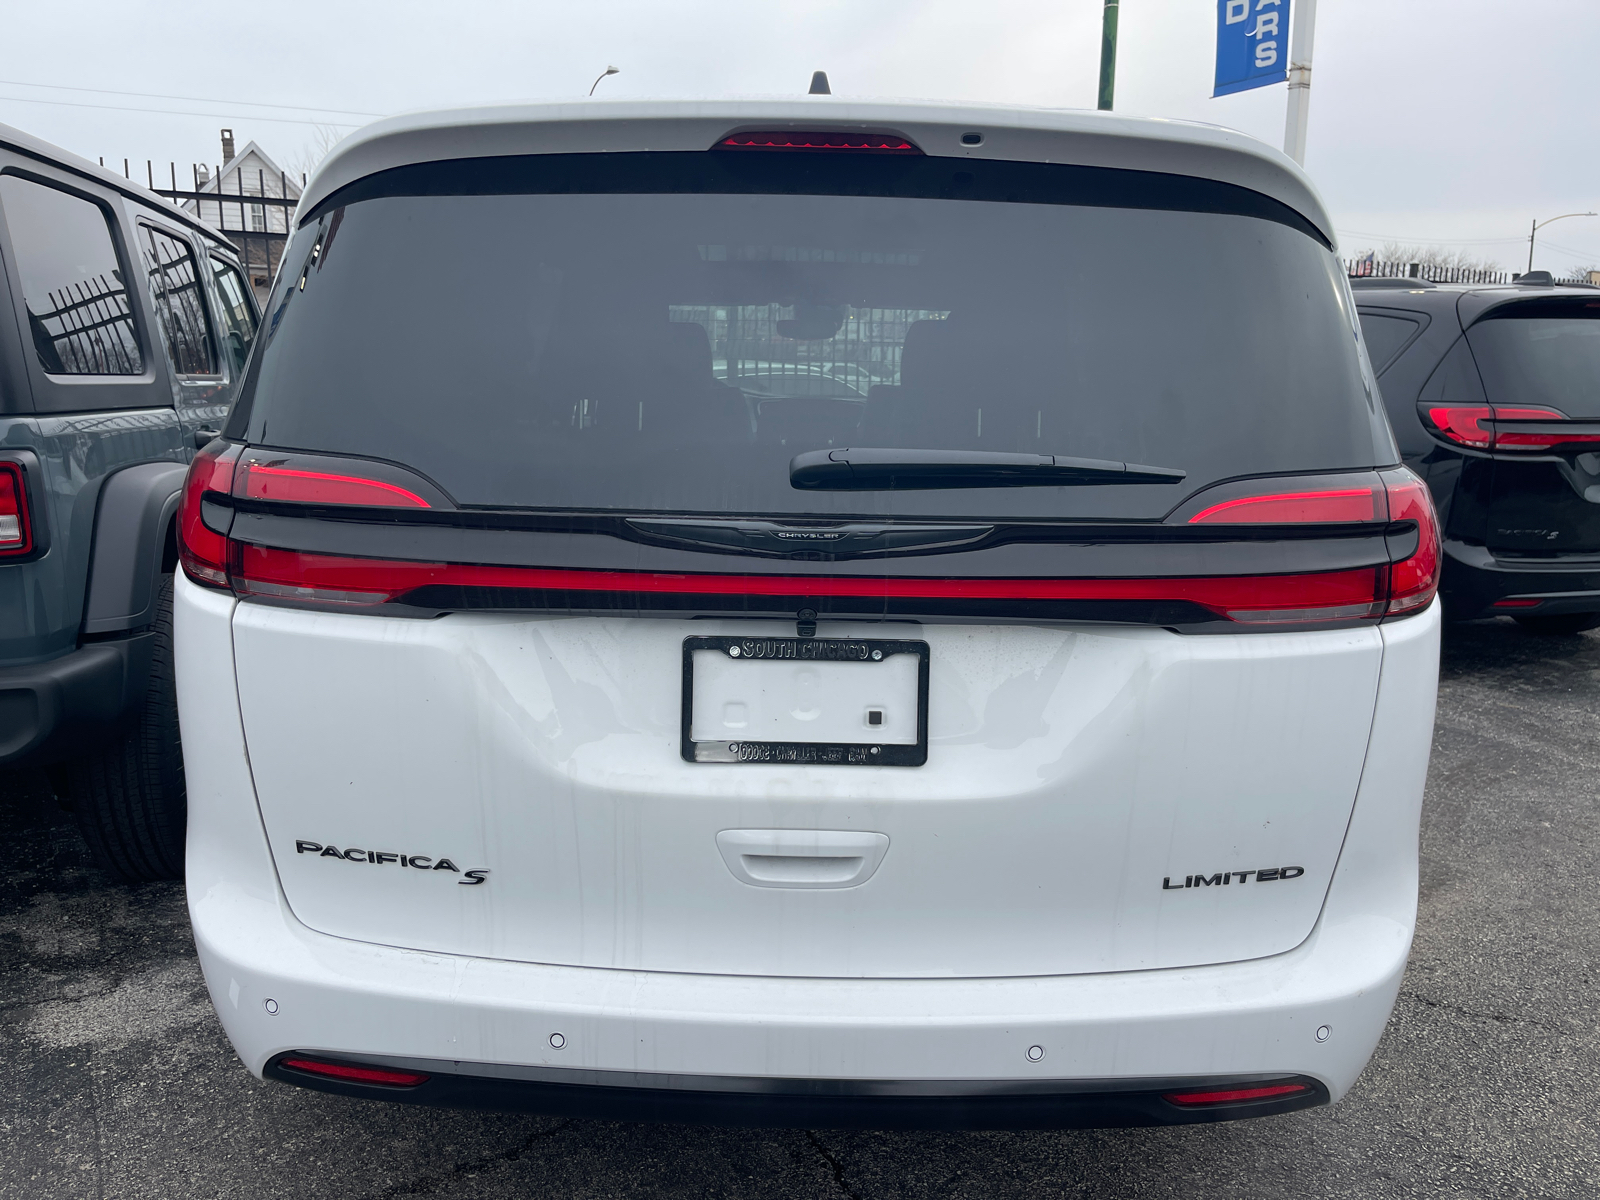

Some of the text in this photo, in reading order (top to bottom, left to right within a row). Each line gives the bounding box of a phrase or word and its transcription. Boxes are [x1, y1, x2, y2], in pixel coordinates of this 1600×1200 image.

[742, 639, 870, 660] SOUTH CHICAGO
[295, 839, 491, 885] PACIFICA S
[1163, 866, 1305, 889] LIMITED
